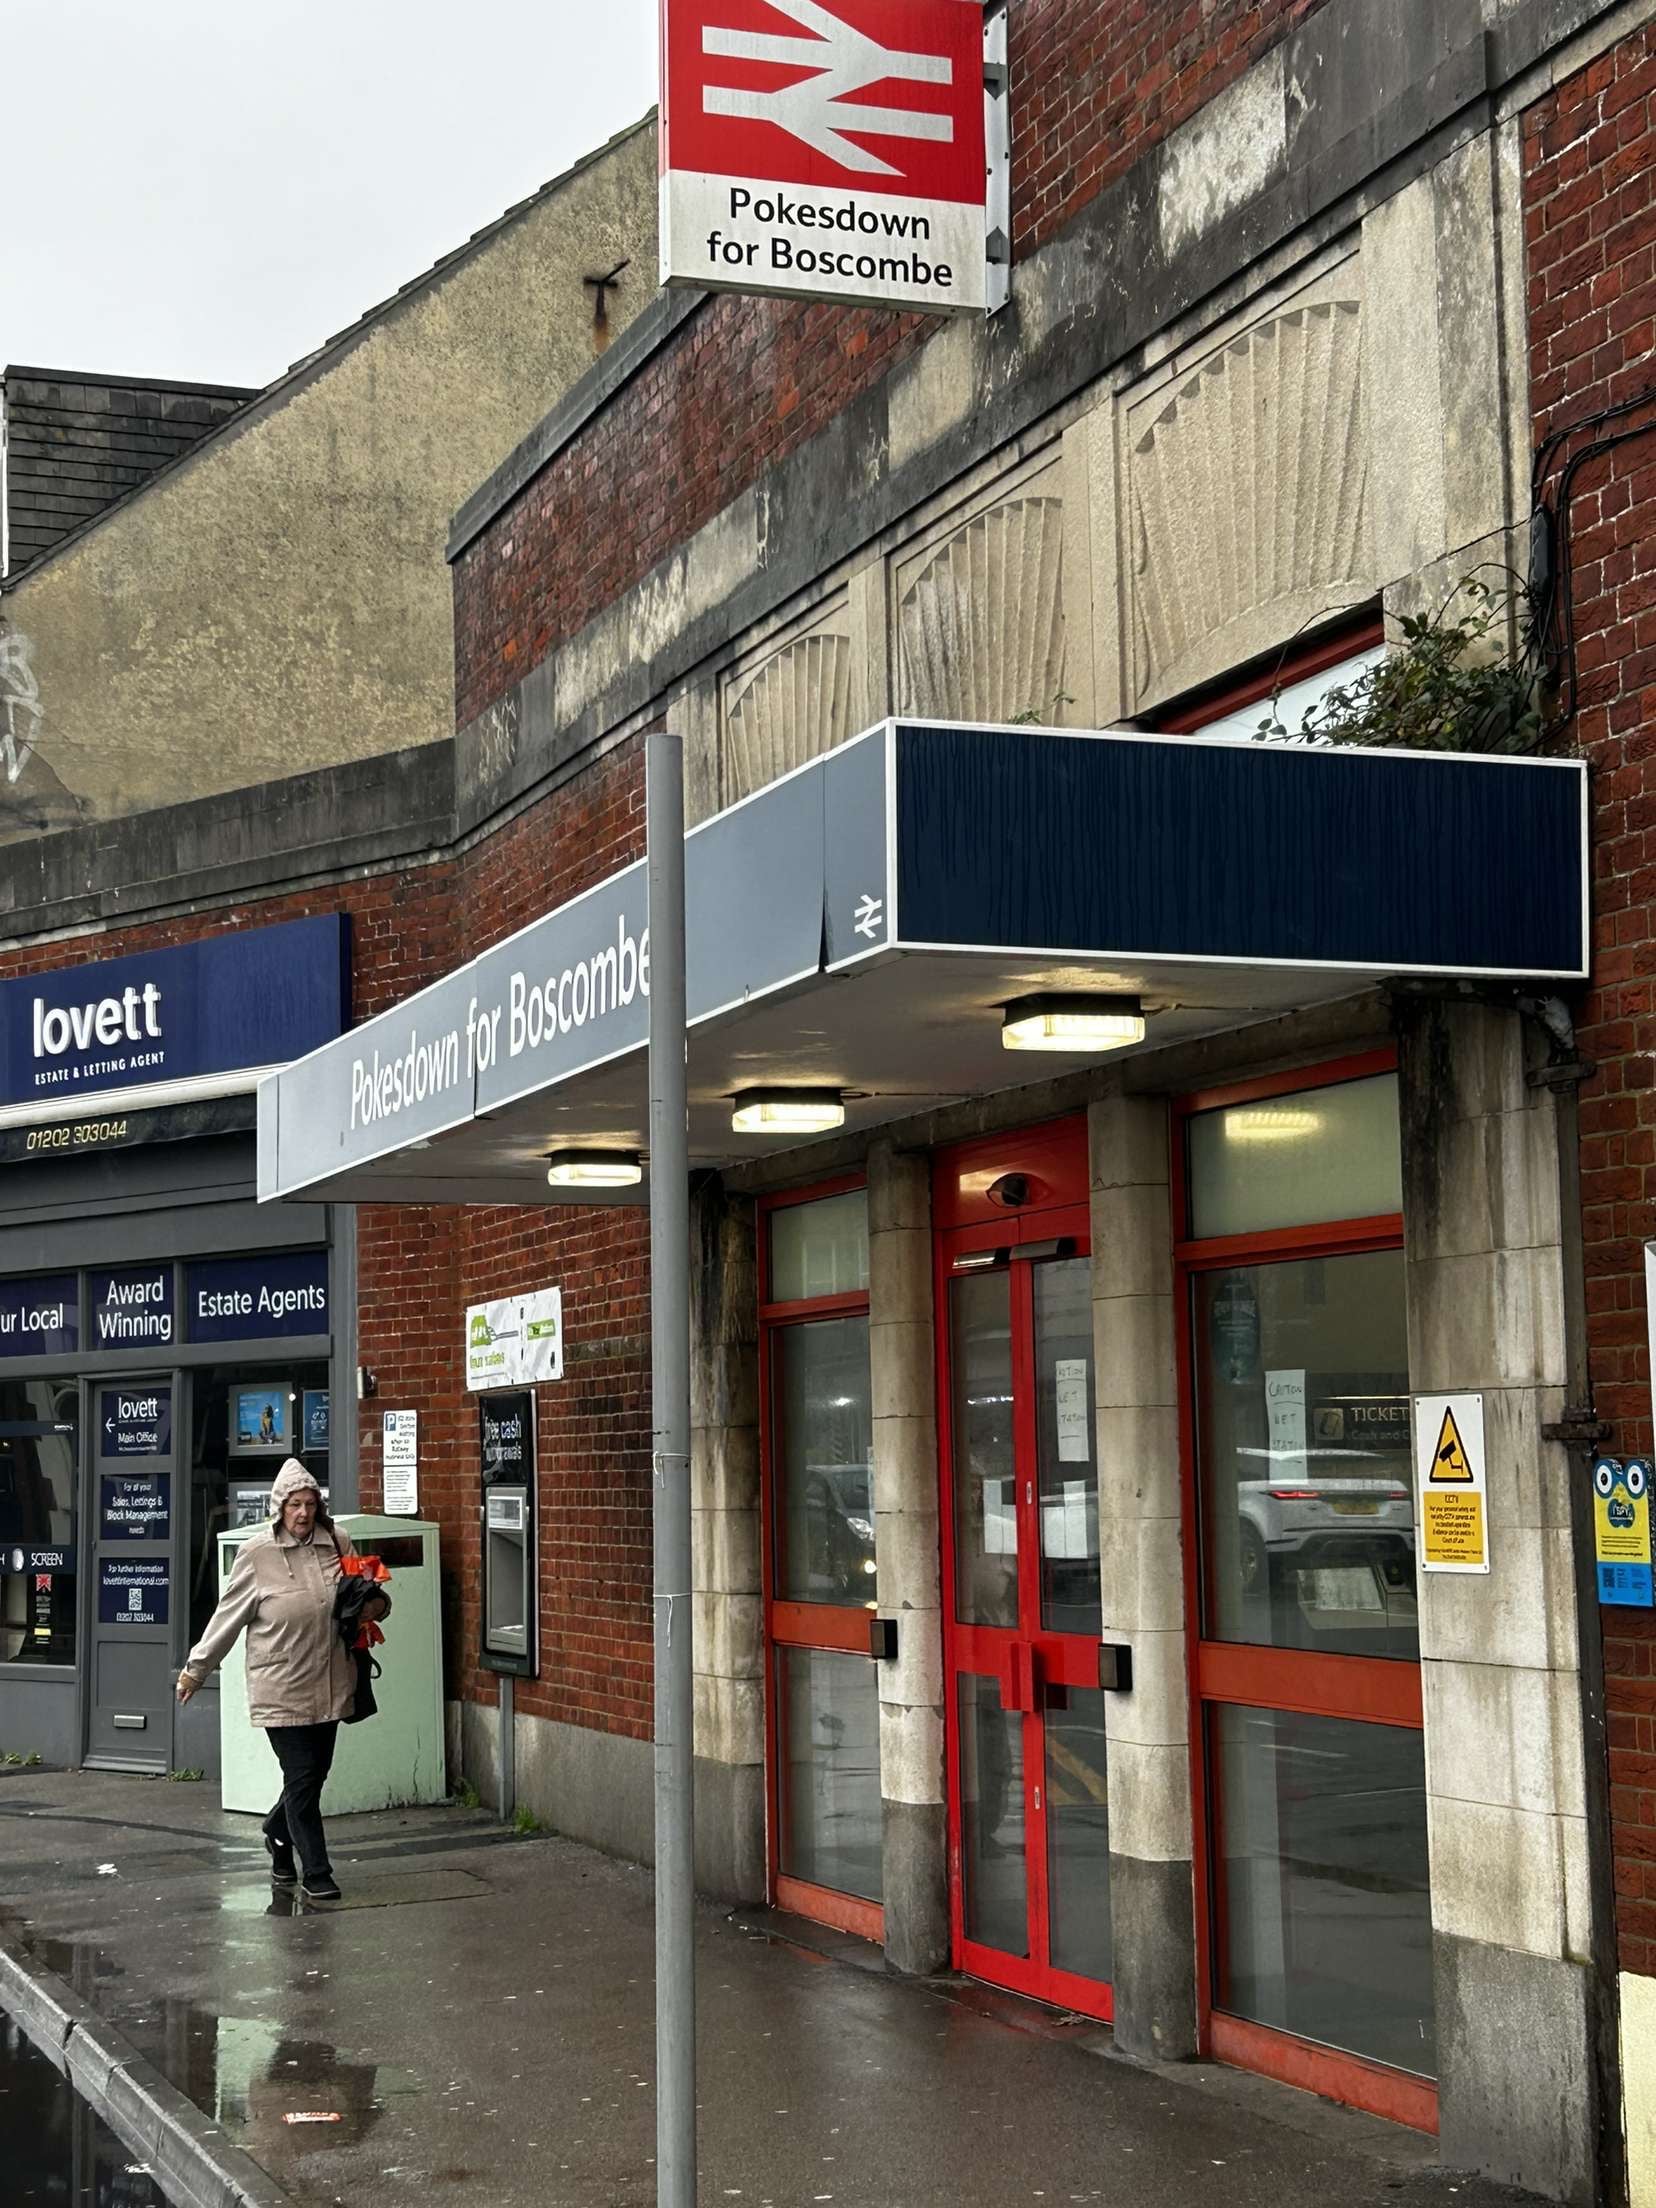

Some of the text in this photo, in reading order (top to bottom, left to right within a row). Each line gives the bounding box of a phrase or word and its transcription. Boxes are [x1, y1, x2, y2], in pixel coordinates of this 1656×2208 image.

[730, 187, 930, 240] Pokesdown
[707, 231, 953, 287] for Boscombe
[33, 983, 162, 1057] lovett
[351, 914, 650, 1130] Pokesdown for Boscombe
[35, 1051, 165, 1085] ESTATE & LETTING AGENT
[26, 1130, 69, 1150] 01202
[106, 1275, 164, 1306] Award
[199, 1285, 326, 1319] Estate Agents
[0, 1303, 63, 1334] ur Local
[100, 1311, 172, 1341] Winning
[118, 1397, 158, 1419] lovett
[118, 1430, 158, 1443] Main Office
[500, 1412, 523, 1439] cash
[107, 1510, 168, 1522] Block Management
[131, 1496, 157, 1508] Lettings
[31, 1552, 64, 1567] SCREEN
